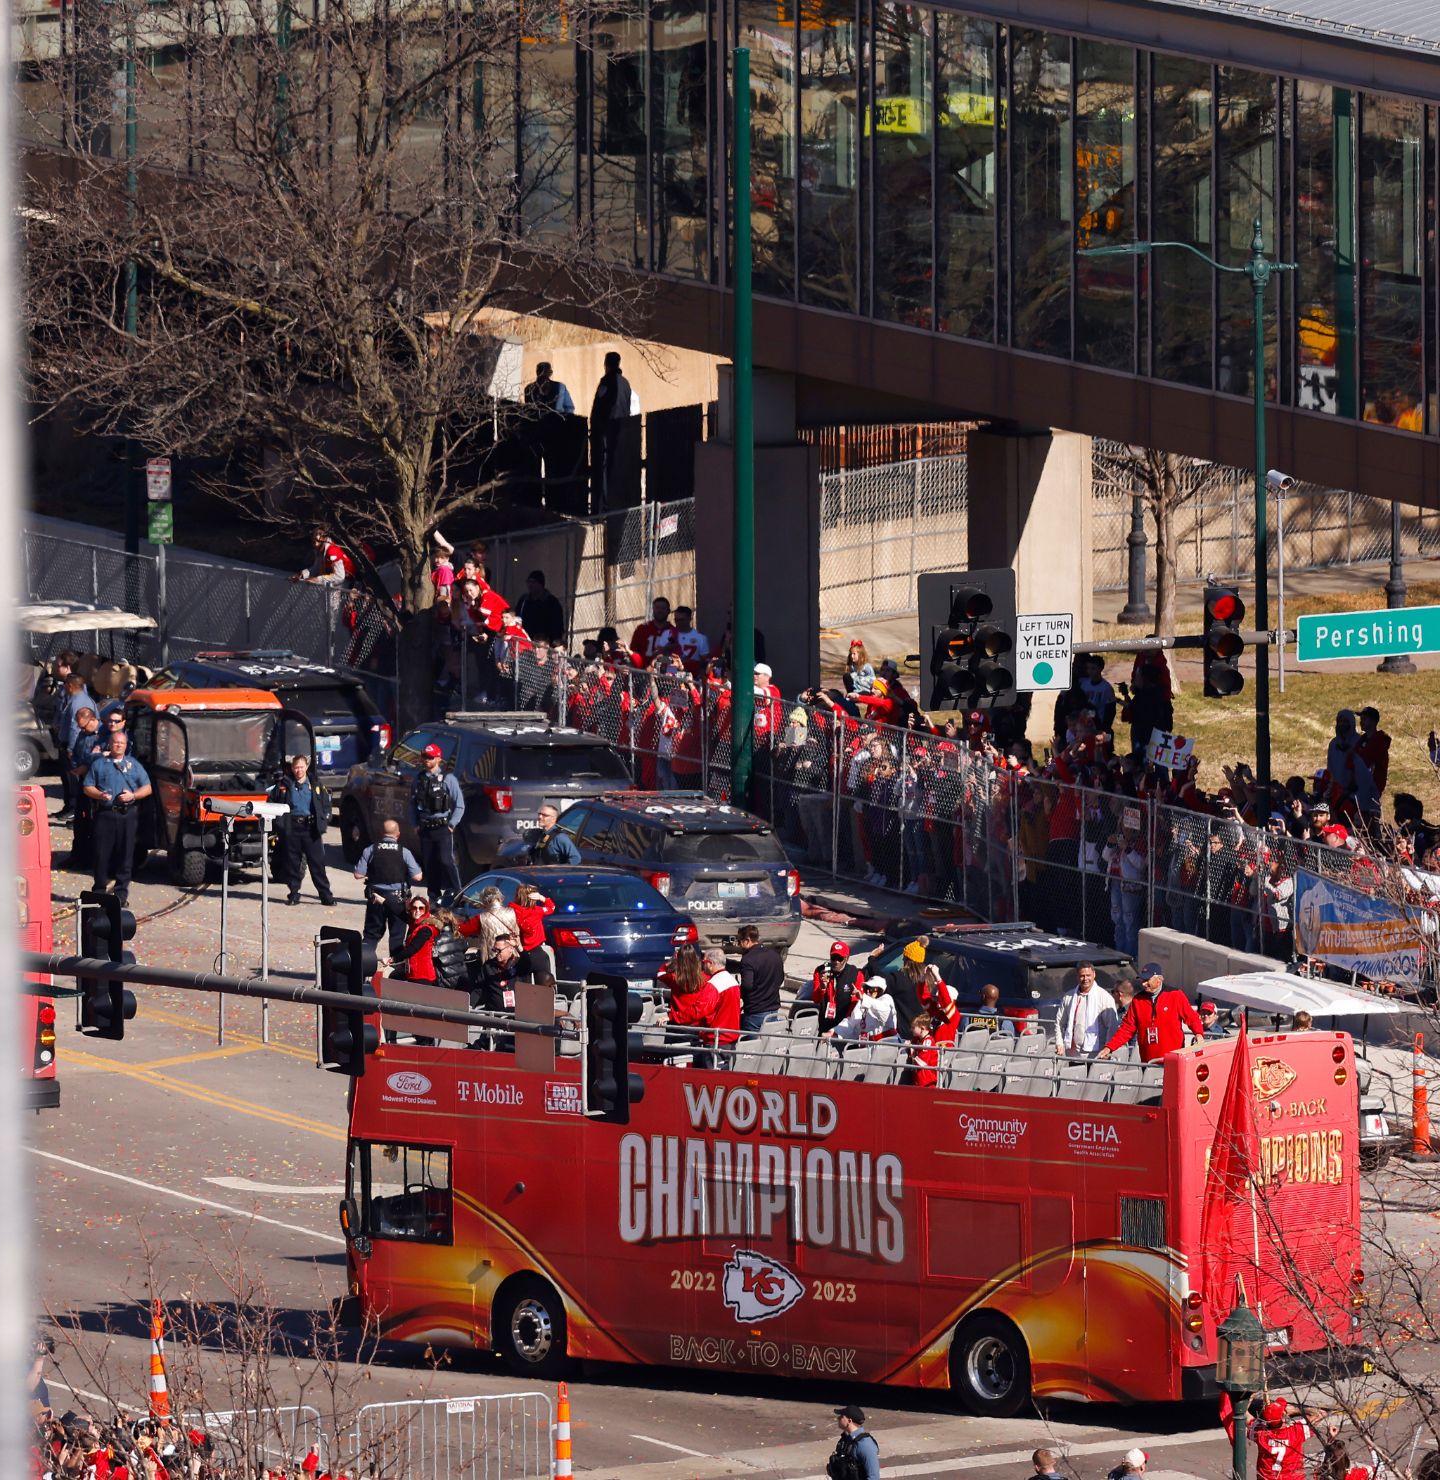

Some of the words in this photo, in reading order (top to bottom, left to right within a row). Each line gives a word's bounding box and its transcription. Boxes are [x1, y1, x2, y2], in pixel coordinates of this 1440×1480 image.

[1019, 621, 1042, 632] LEFT
[1045, 620, 1070, 631] TURN
[1315, 620, 1423, 649] Pershing
[1023, 634, 1065, 647] YIELD
[1019, 650, 1033, 661] ON
[1036, 649, 1069, 660] GREEN
[687, 900, 724, 911] POLICE
[396, 1075, 423, 1091] Ford
[473, 1081, 524, 1106] Mobile
[552, 1085, 579, 1100] BUD
[382, 1094, 404, 1104] Midwest
[404, 1095, 417, 1104] Ford
[416, 1096, 437, 1106] Dealers
[547, 1098, 583, 1113] LIGHT
[682, 1082, 838, 1138] WORLD
[1290, 1098, 1327, 1118] BACK
[958, 1113, 1027, 1136] Community
[1067, 1121, 1120, 1144] GEHA
[619, 1132, 906, 1265] CHAMPIONS
[670, 1269, 717, 1292] 2022
[741, 1266, 785, 1307] KC
[812, 1280, 858, 1303] 2023
[669, 1334, 737, 1365] BACK
[746, 1340, 780, 1367] TO
[792, 1344, 858, 1375] BACK
[1271, 1446, 1287, 1472] 7
